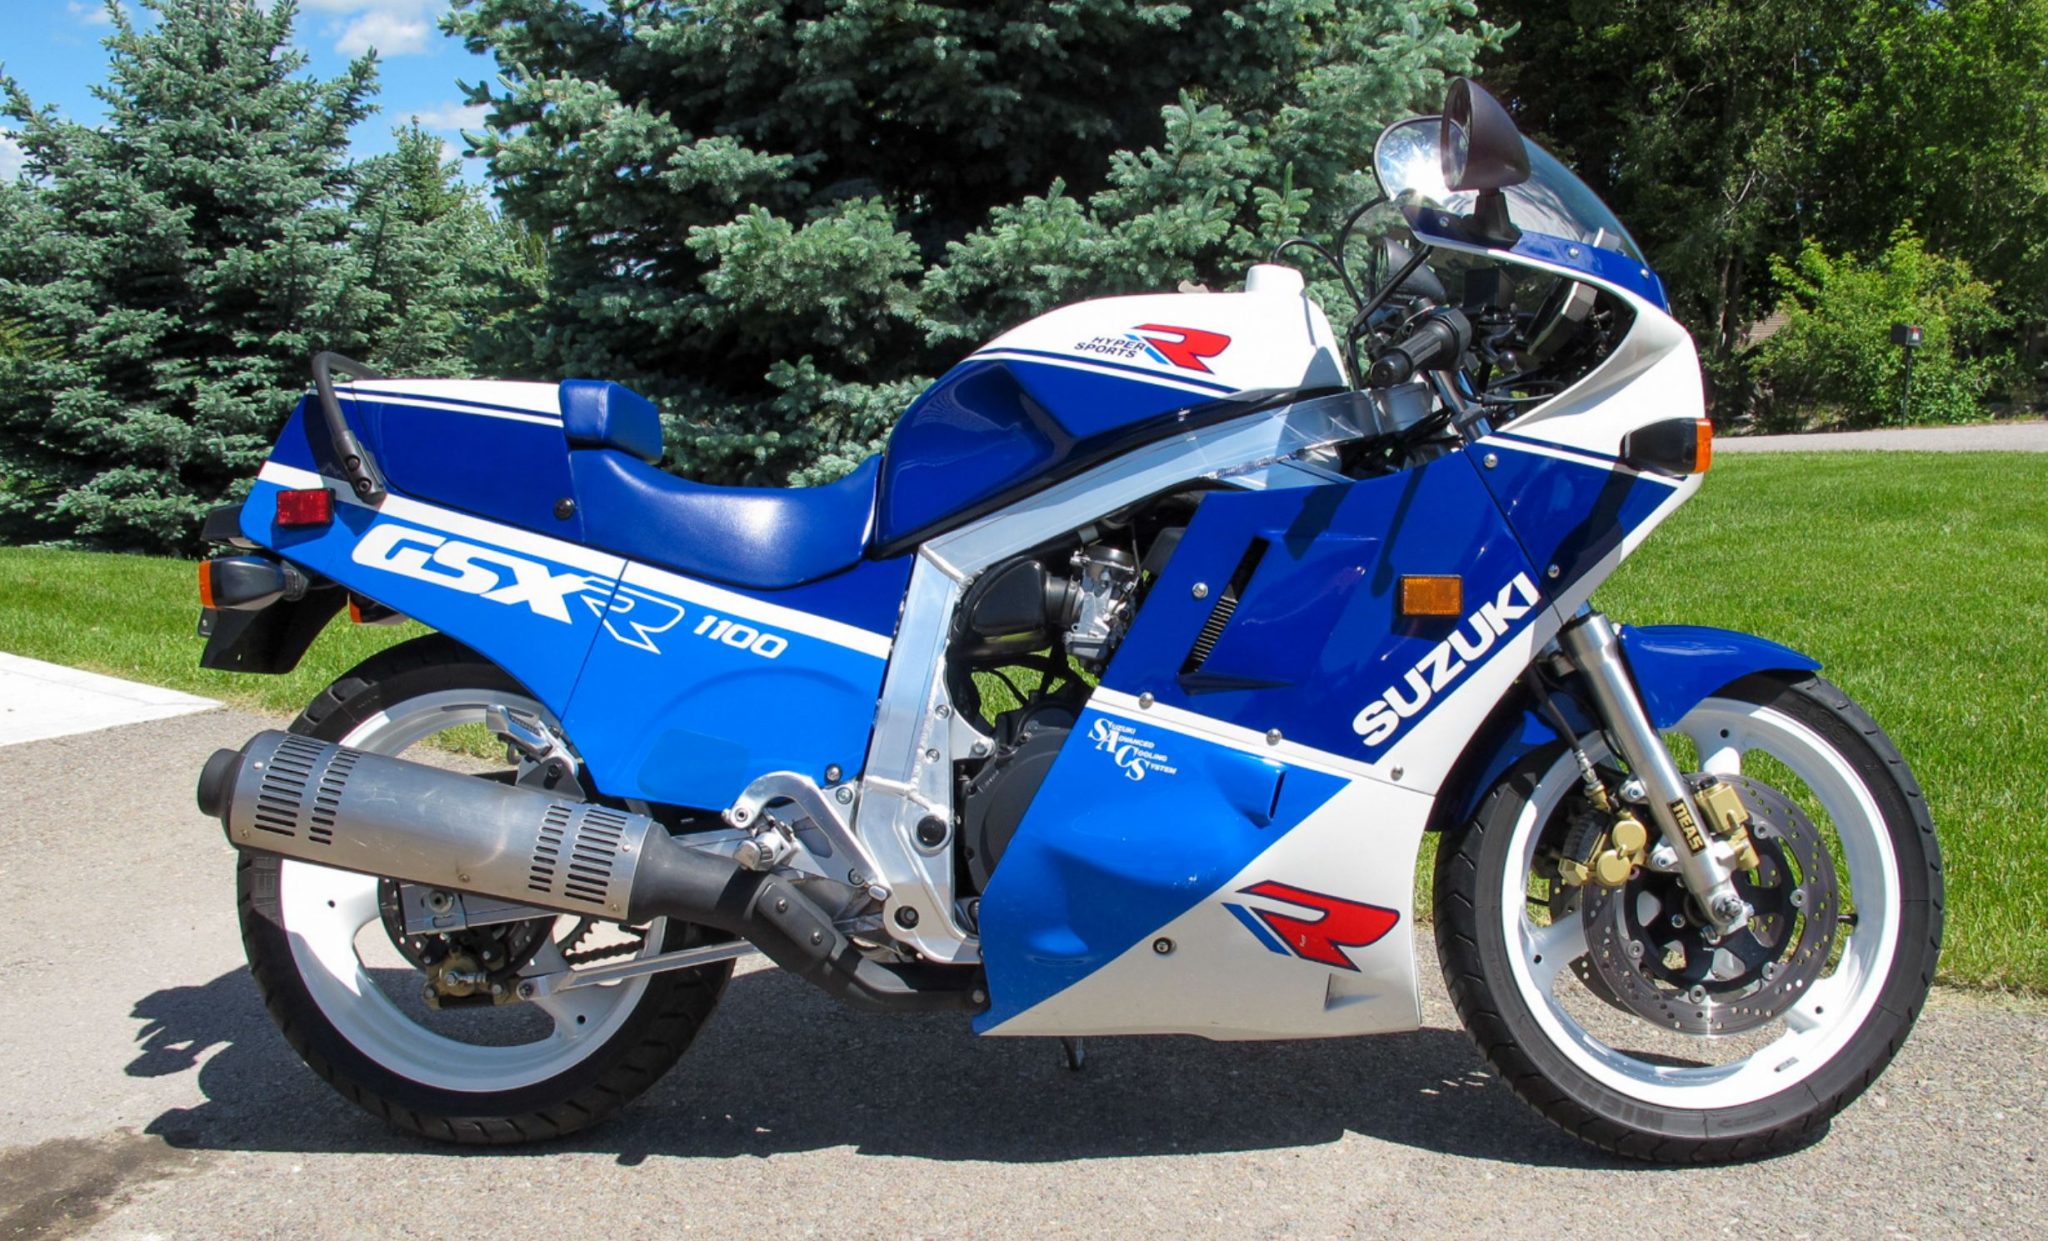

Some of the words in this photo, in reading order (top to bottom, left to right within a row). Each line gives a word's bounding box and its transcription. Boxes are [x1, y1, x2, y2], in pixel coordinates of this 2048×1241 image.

[1074, 342, 1138, 359] SPORTS
[1092, 336, 1146, 351] HYPER
[1130, 323, 1232, 375] R
[693, 615, 789, 659] 1100
[1352, 571, 1541, 747] SUZUKI
[1235, 879, 1401, 973] R
